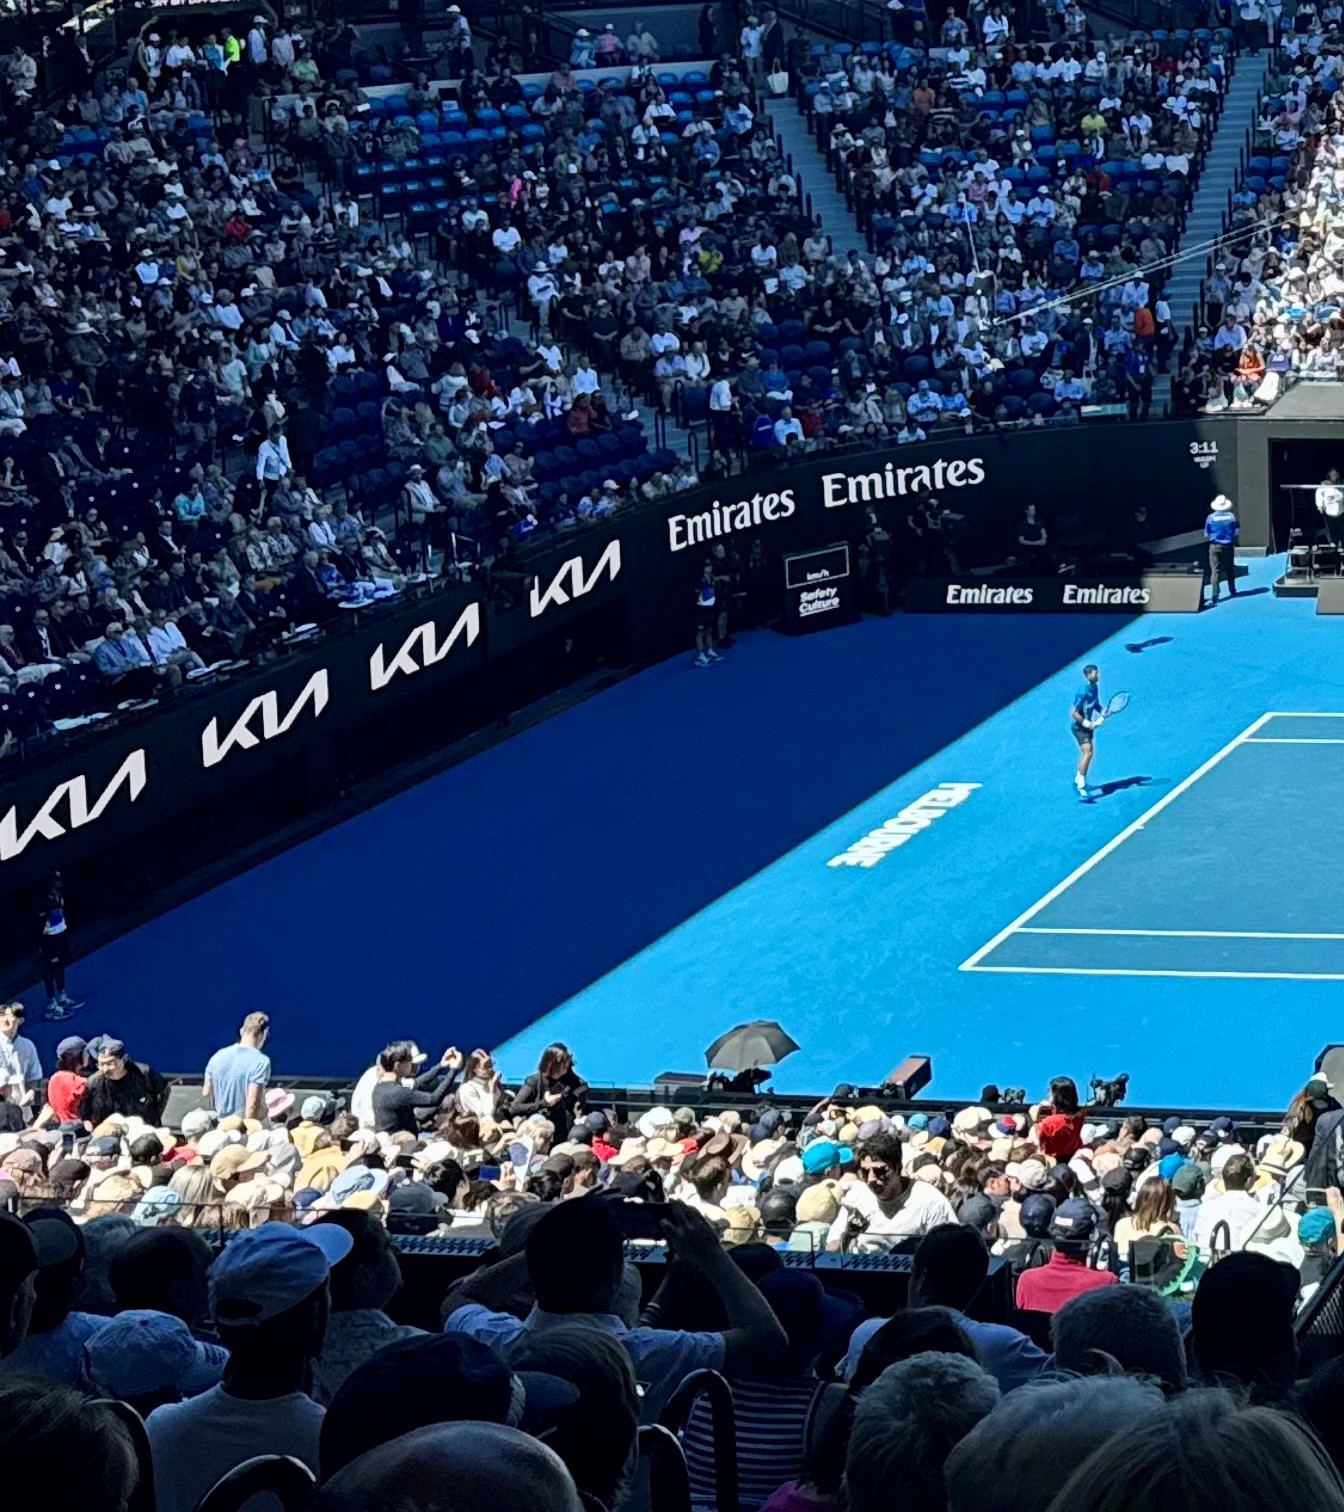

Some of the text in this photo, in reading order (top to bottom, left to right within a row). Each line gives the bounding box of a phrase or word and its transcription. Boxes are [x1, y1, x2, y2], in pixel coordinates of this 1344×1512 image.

[1190, 441, 1218, 454] 3:11
[822, 456, 986, 508] Emirates
[668, 488, 796, 552] Emirates
[530, 540, 622, 618] KIA
[800, 587, 838, 602] Safety
[946, 584, 1033, 604] Emirates
[1062, 584, 1150, 604] Emirates
[799, 597, 840, 614] Culture
[370, 602, 480, 691] KIA
[202, 668, 328, 768] KIA
[0, 748, 147, 861] KIA
